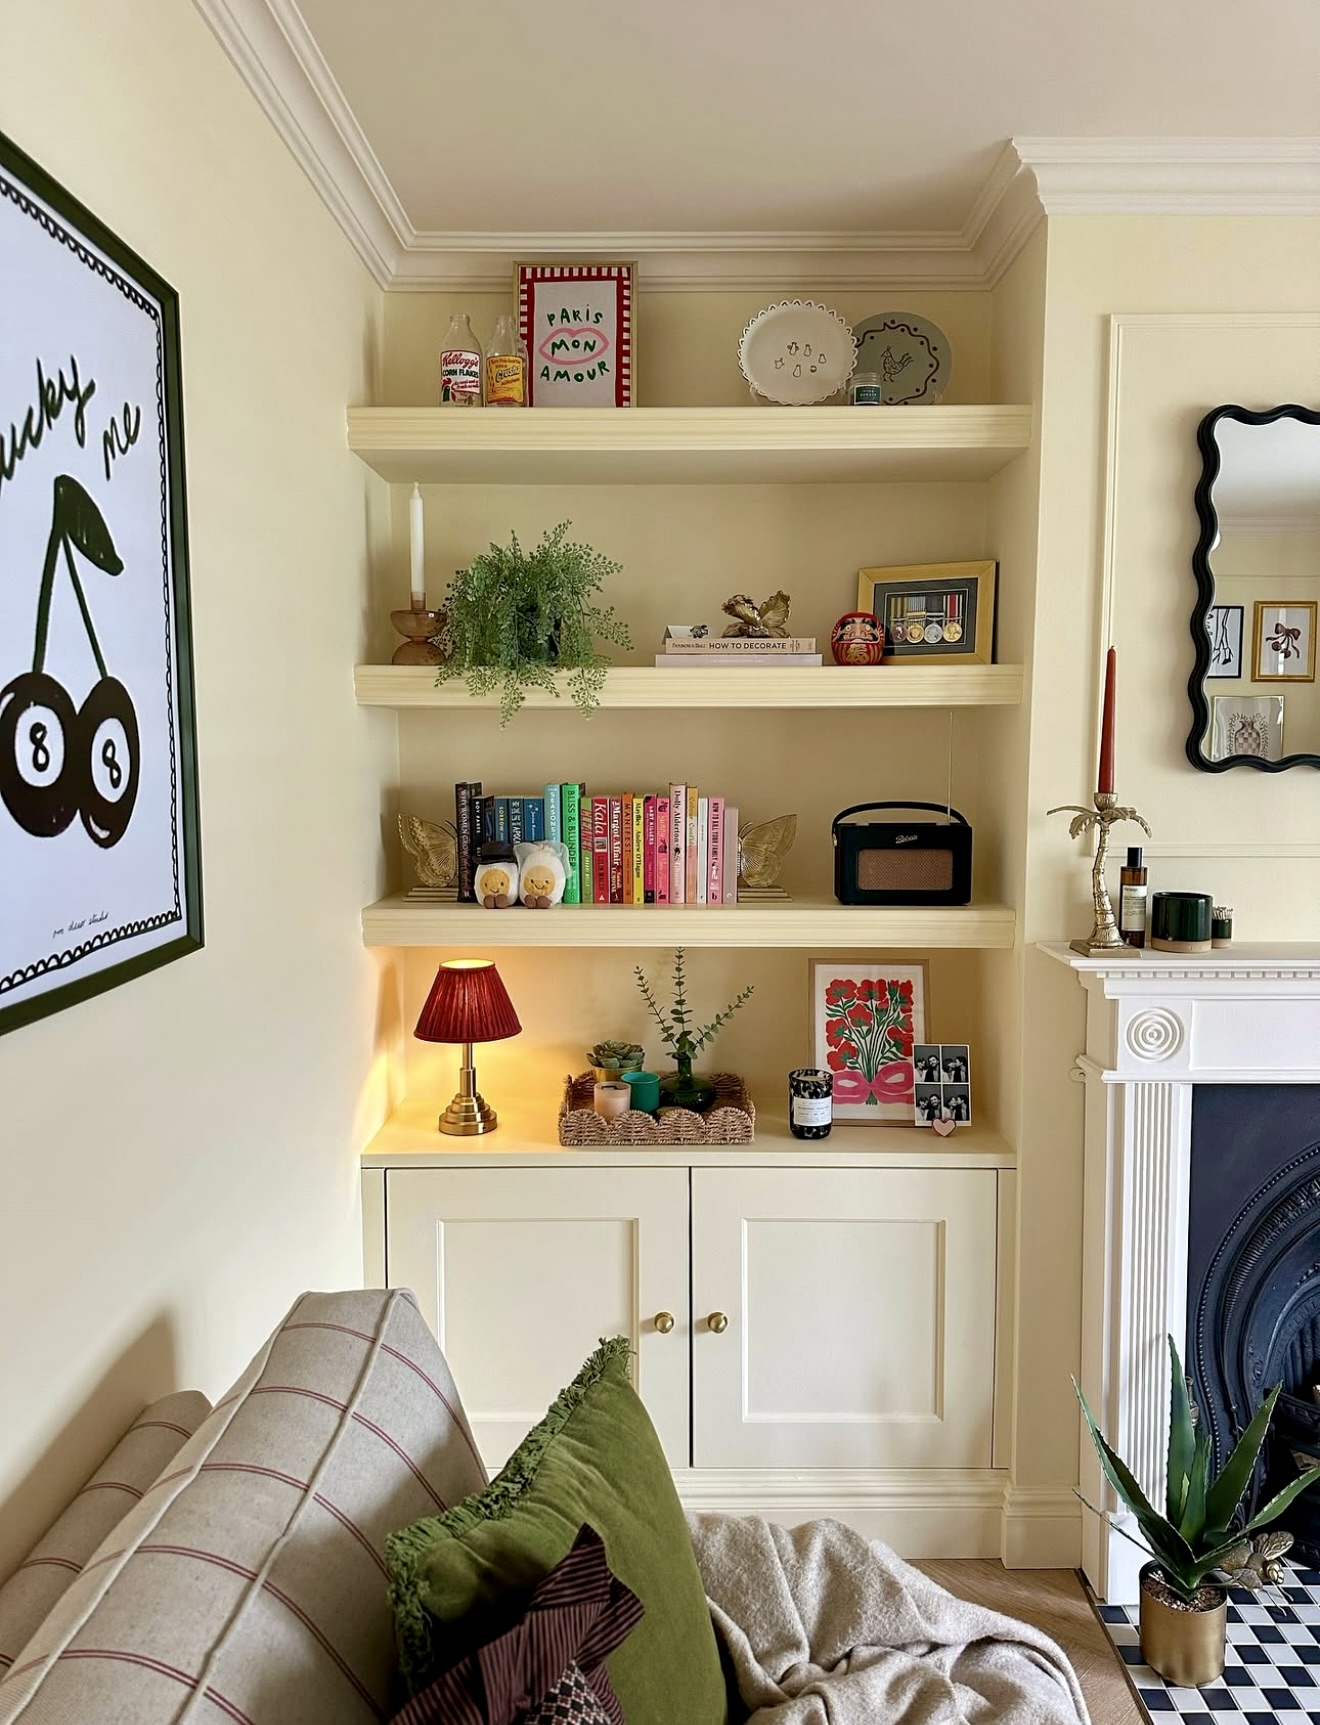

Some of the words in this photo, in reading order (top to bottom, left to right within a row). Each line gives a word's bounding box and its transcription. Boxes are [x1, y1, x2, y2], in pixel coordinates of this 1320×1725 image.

[551, 339, 596, 358] MON
[442, 352, 478, 369] Kellogg's
[443, 369, 458, 377] CORN
[459, 369, 479, 379] FLAKES
[540, 361, 610, 382] AMOUR
[0, 354, 96, 500] ucky
[103, 401, 141, 481] me
[709, 642, 730, 650] HOW
[731, 642, 742, 650] TO
[743, 642, 787, 650] DECORATE
[30, 721, 50, 773] 8
[102, 738, 122, 790] 8
[567, 790, 576, 813] BLISS
[673, 790, 681, 809] Dolly
[711, 802, 719, 812] HOW
[594, 803, 606, 834] Kala
[611, 806, 621, 838] Margot
[634, 802, 642, 825] Mayflies
[711, 820, 719, 831] KILL
[711, 831, 719, 844] YOUR
[613, 839, 622, 866] Affair
[711, 844, 719, 861] FAMILY
